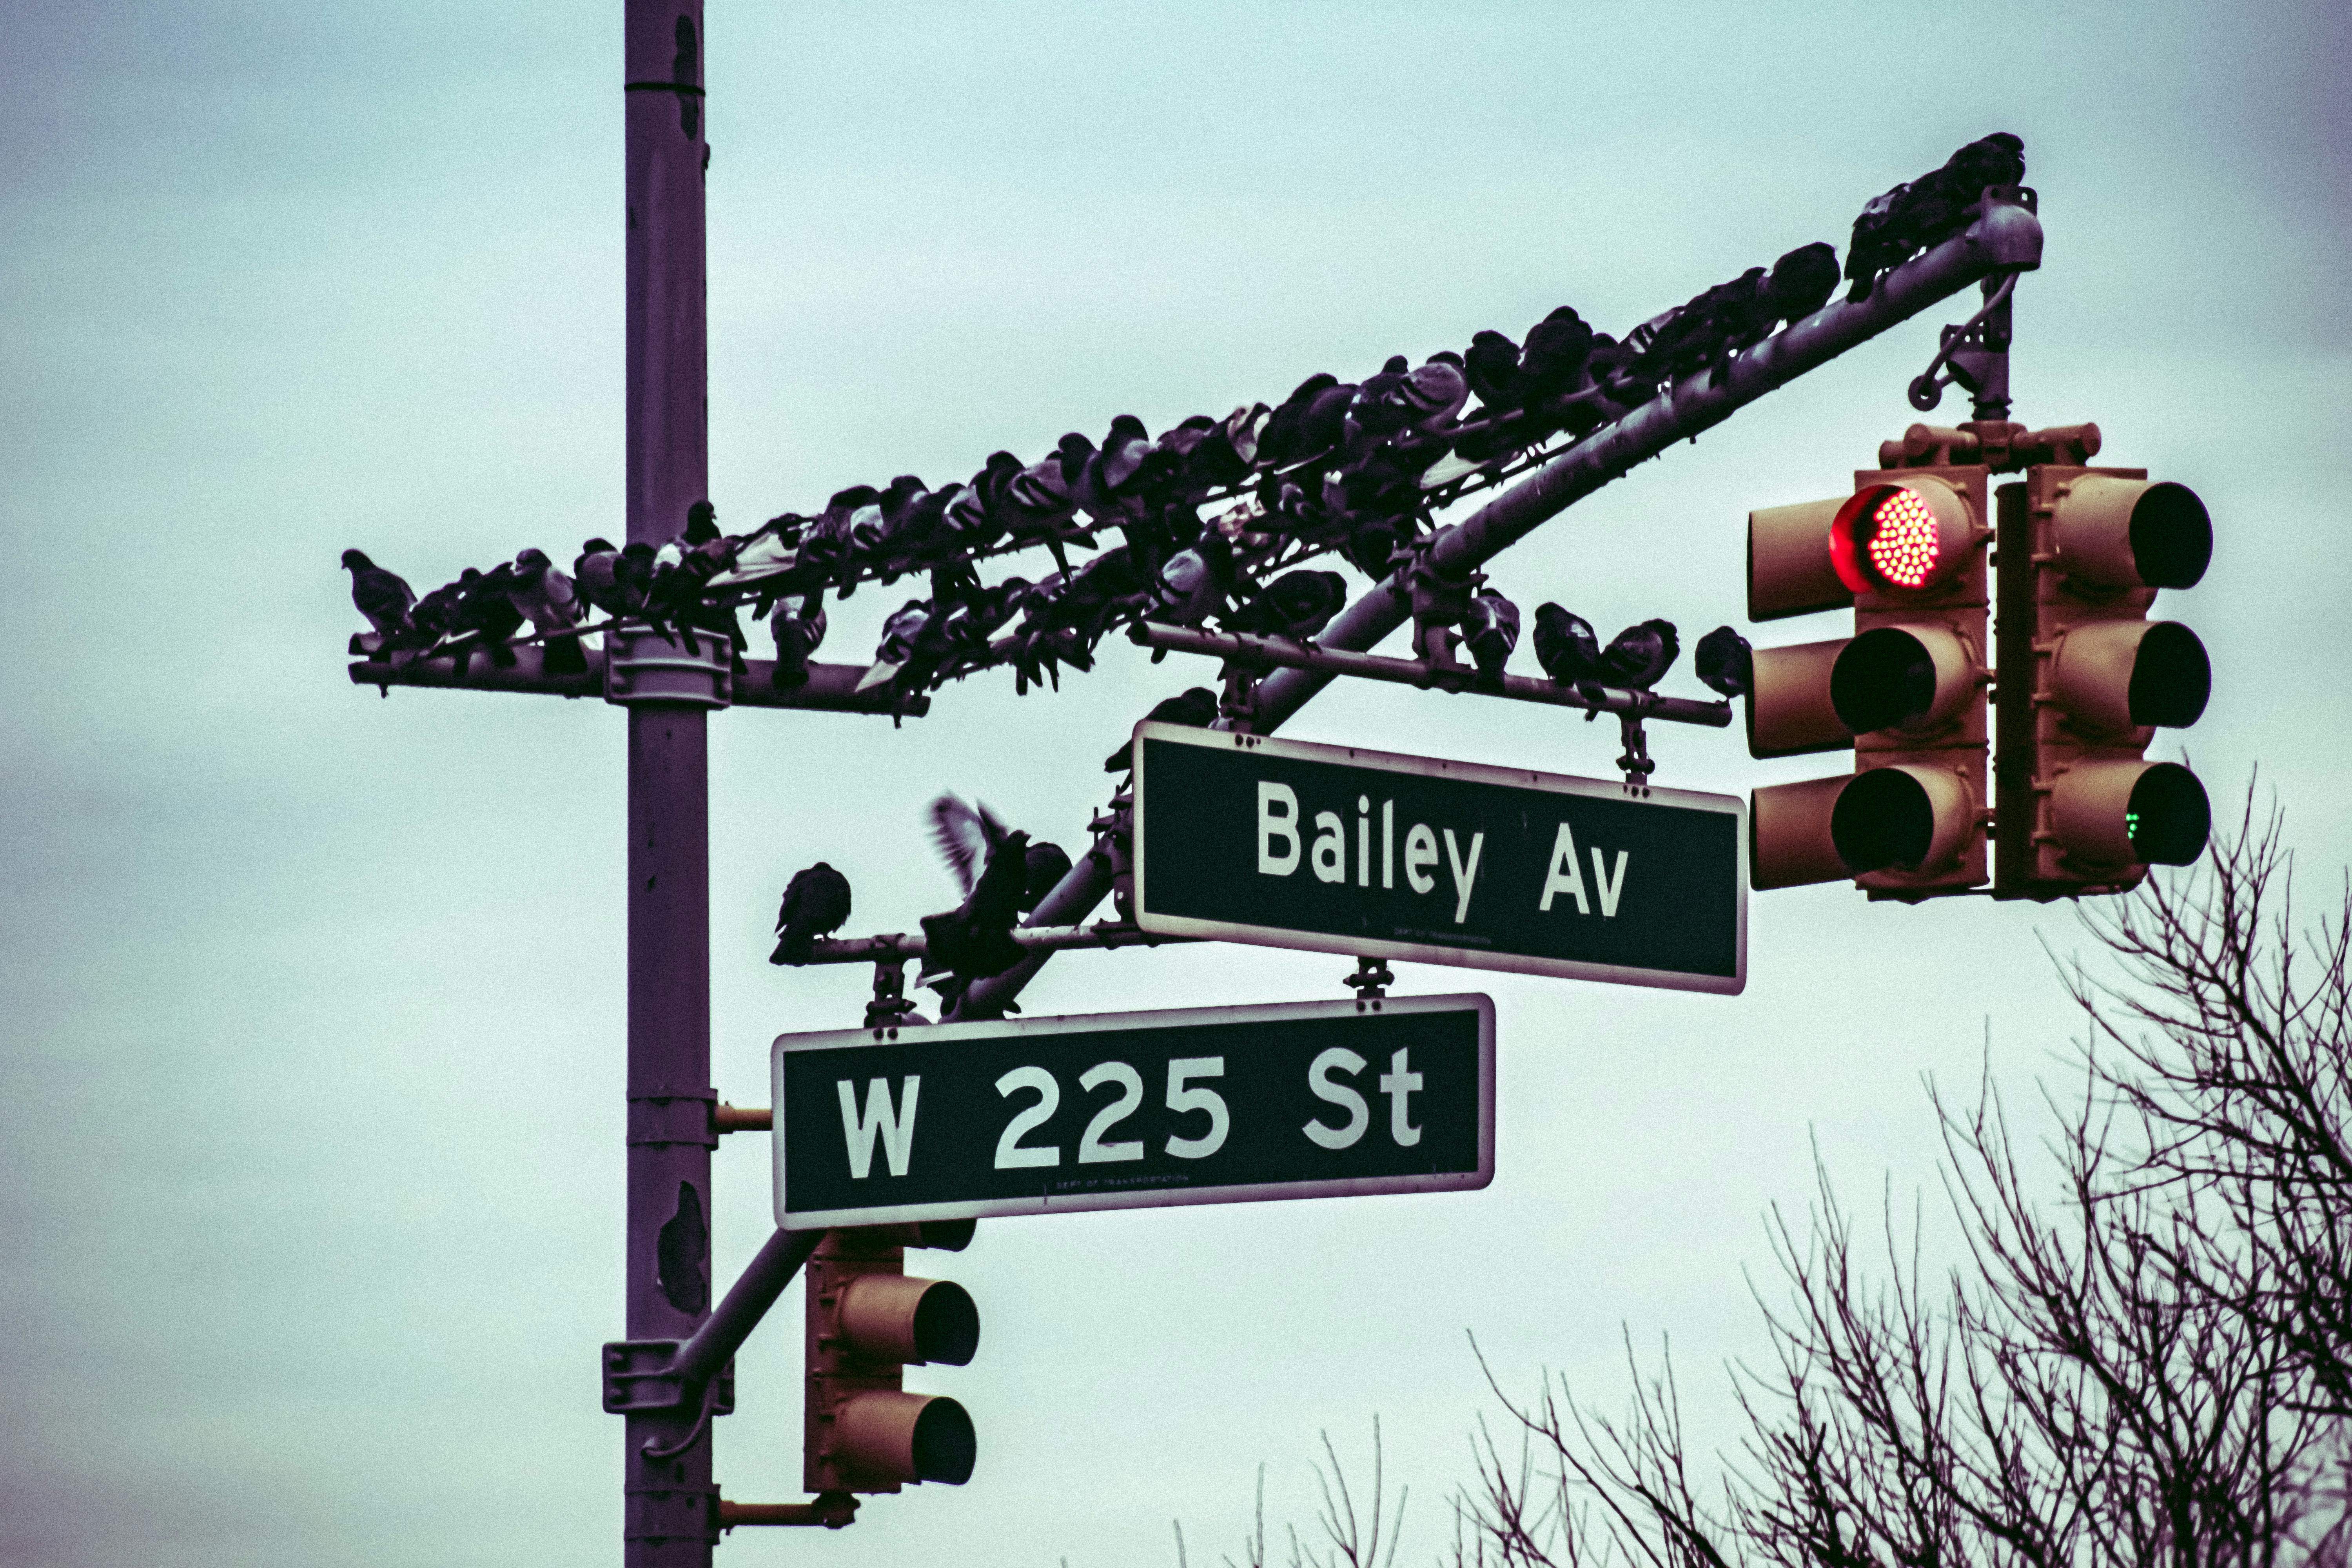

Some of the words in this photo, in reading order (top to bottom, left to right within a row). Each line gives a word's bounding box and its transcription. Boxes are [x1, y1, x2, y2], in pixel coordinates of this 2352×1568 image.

[1258, 780, 1484, 924] Bailey
[1539, 822, 1629, 917] Av
[837, 1075, 921, 1179] W
[994, 1056, 1230, 1170] 225
[1302, 1047, 1423, 1149] St
